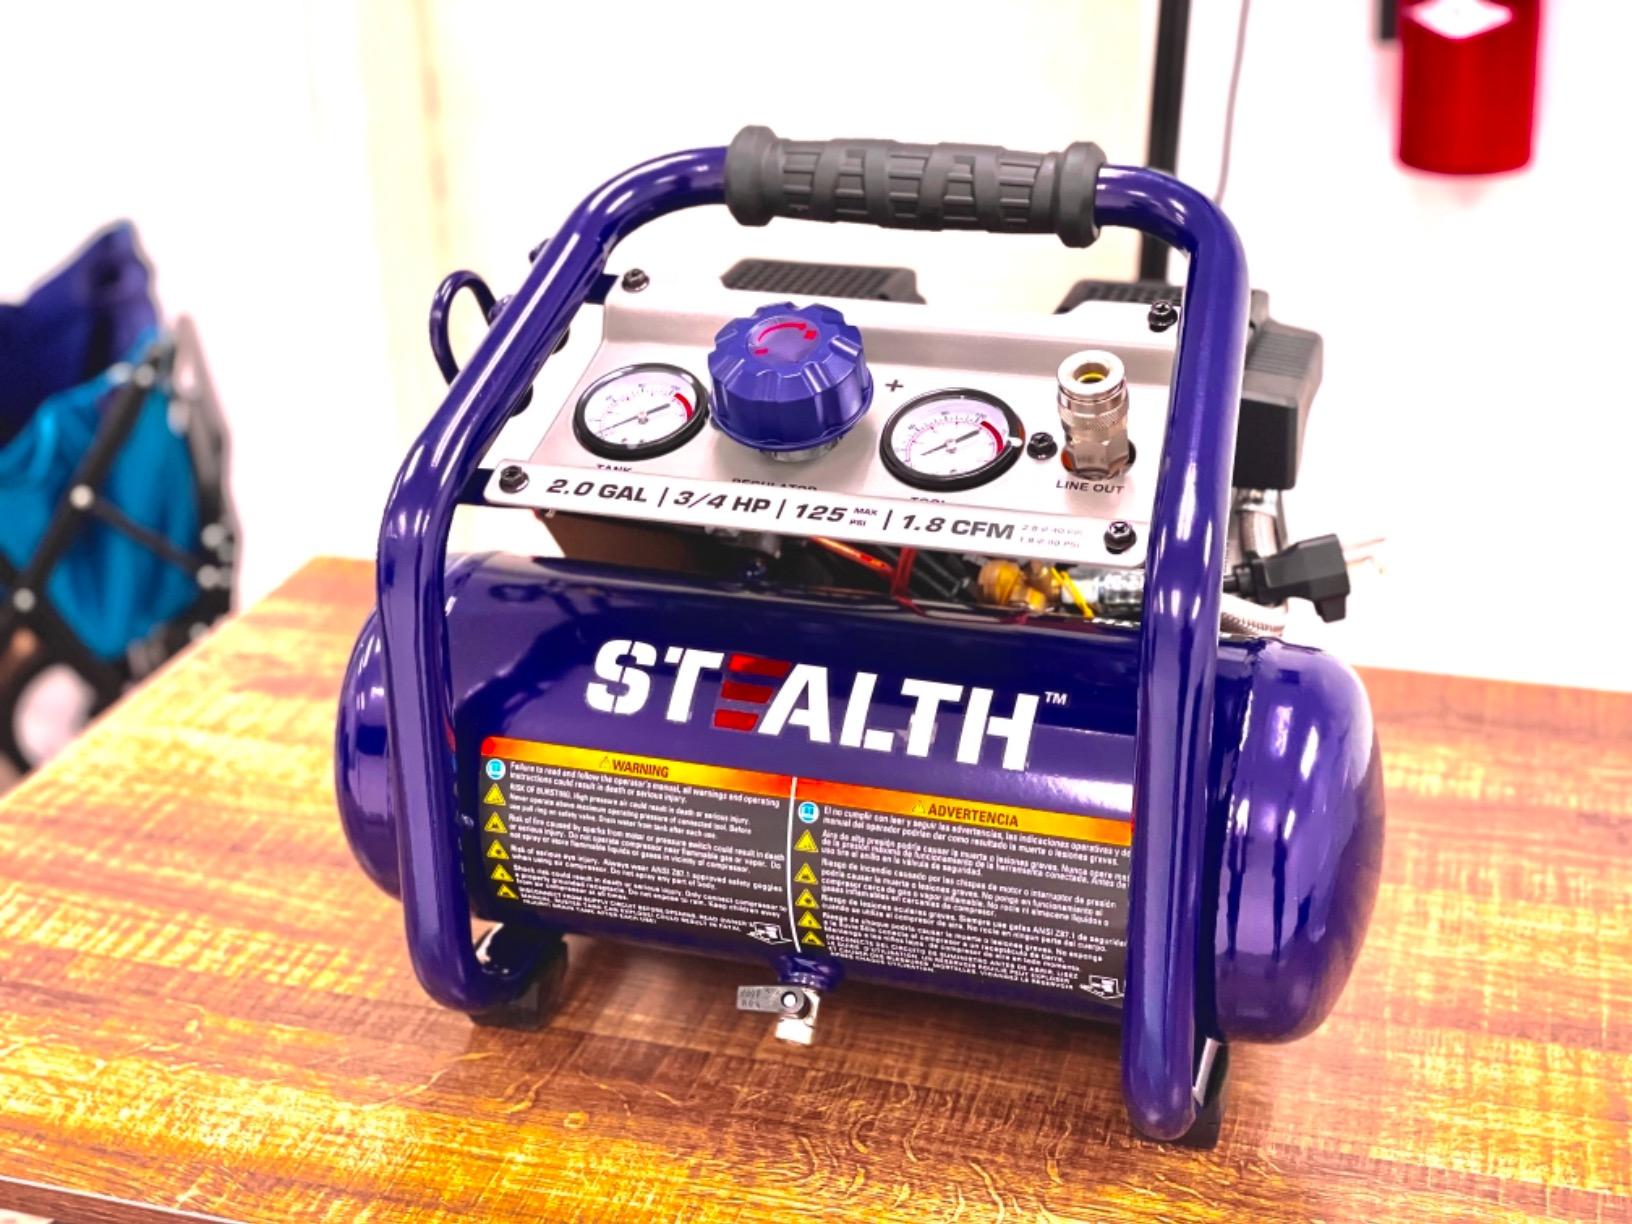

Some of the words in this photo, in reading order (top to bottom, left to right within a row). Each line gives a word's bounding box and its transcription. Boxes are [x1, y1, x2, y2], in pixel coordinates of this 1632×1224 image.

[1056, 480, 1089, 491] LINE
[1093, 484, 1125, 494] OUT
[546, 479, 593, 496] 2.0
[599, 484, 647, 503] GAL
[673, 490, 724, 510] 3/4
[732, 497, 770, 514] HP
[795, 503, 848, 522] 125
[849, 519, 866, 527] PSI
[853, 508, 878, 517] MAX
[902, 514, 946, 532] 1.8
[950, 520, 1015, 540] CFM
[585, 639, 1040, 771] STEALTH
[612, 759, 669, 778] WARNING
[510, 762, 534, 771] Failure
[577, 771, 599, 780] follow
[613, 778, 650, 788] operator's
[652, 783, 680, 794] manual,
[693, 789, 726, 800] warnings
[743, 797, 779, 808] operating
[605, 784, 624, 793] death
[635, 790, 662, 799] serious
[664, 794, 687, 803] injury.
[928, 804, 1019, 827] ADVERTENCIA
